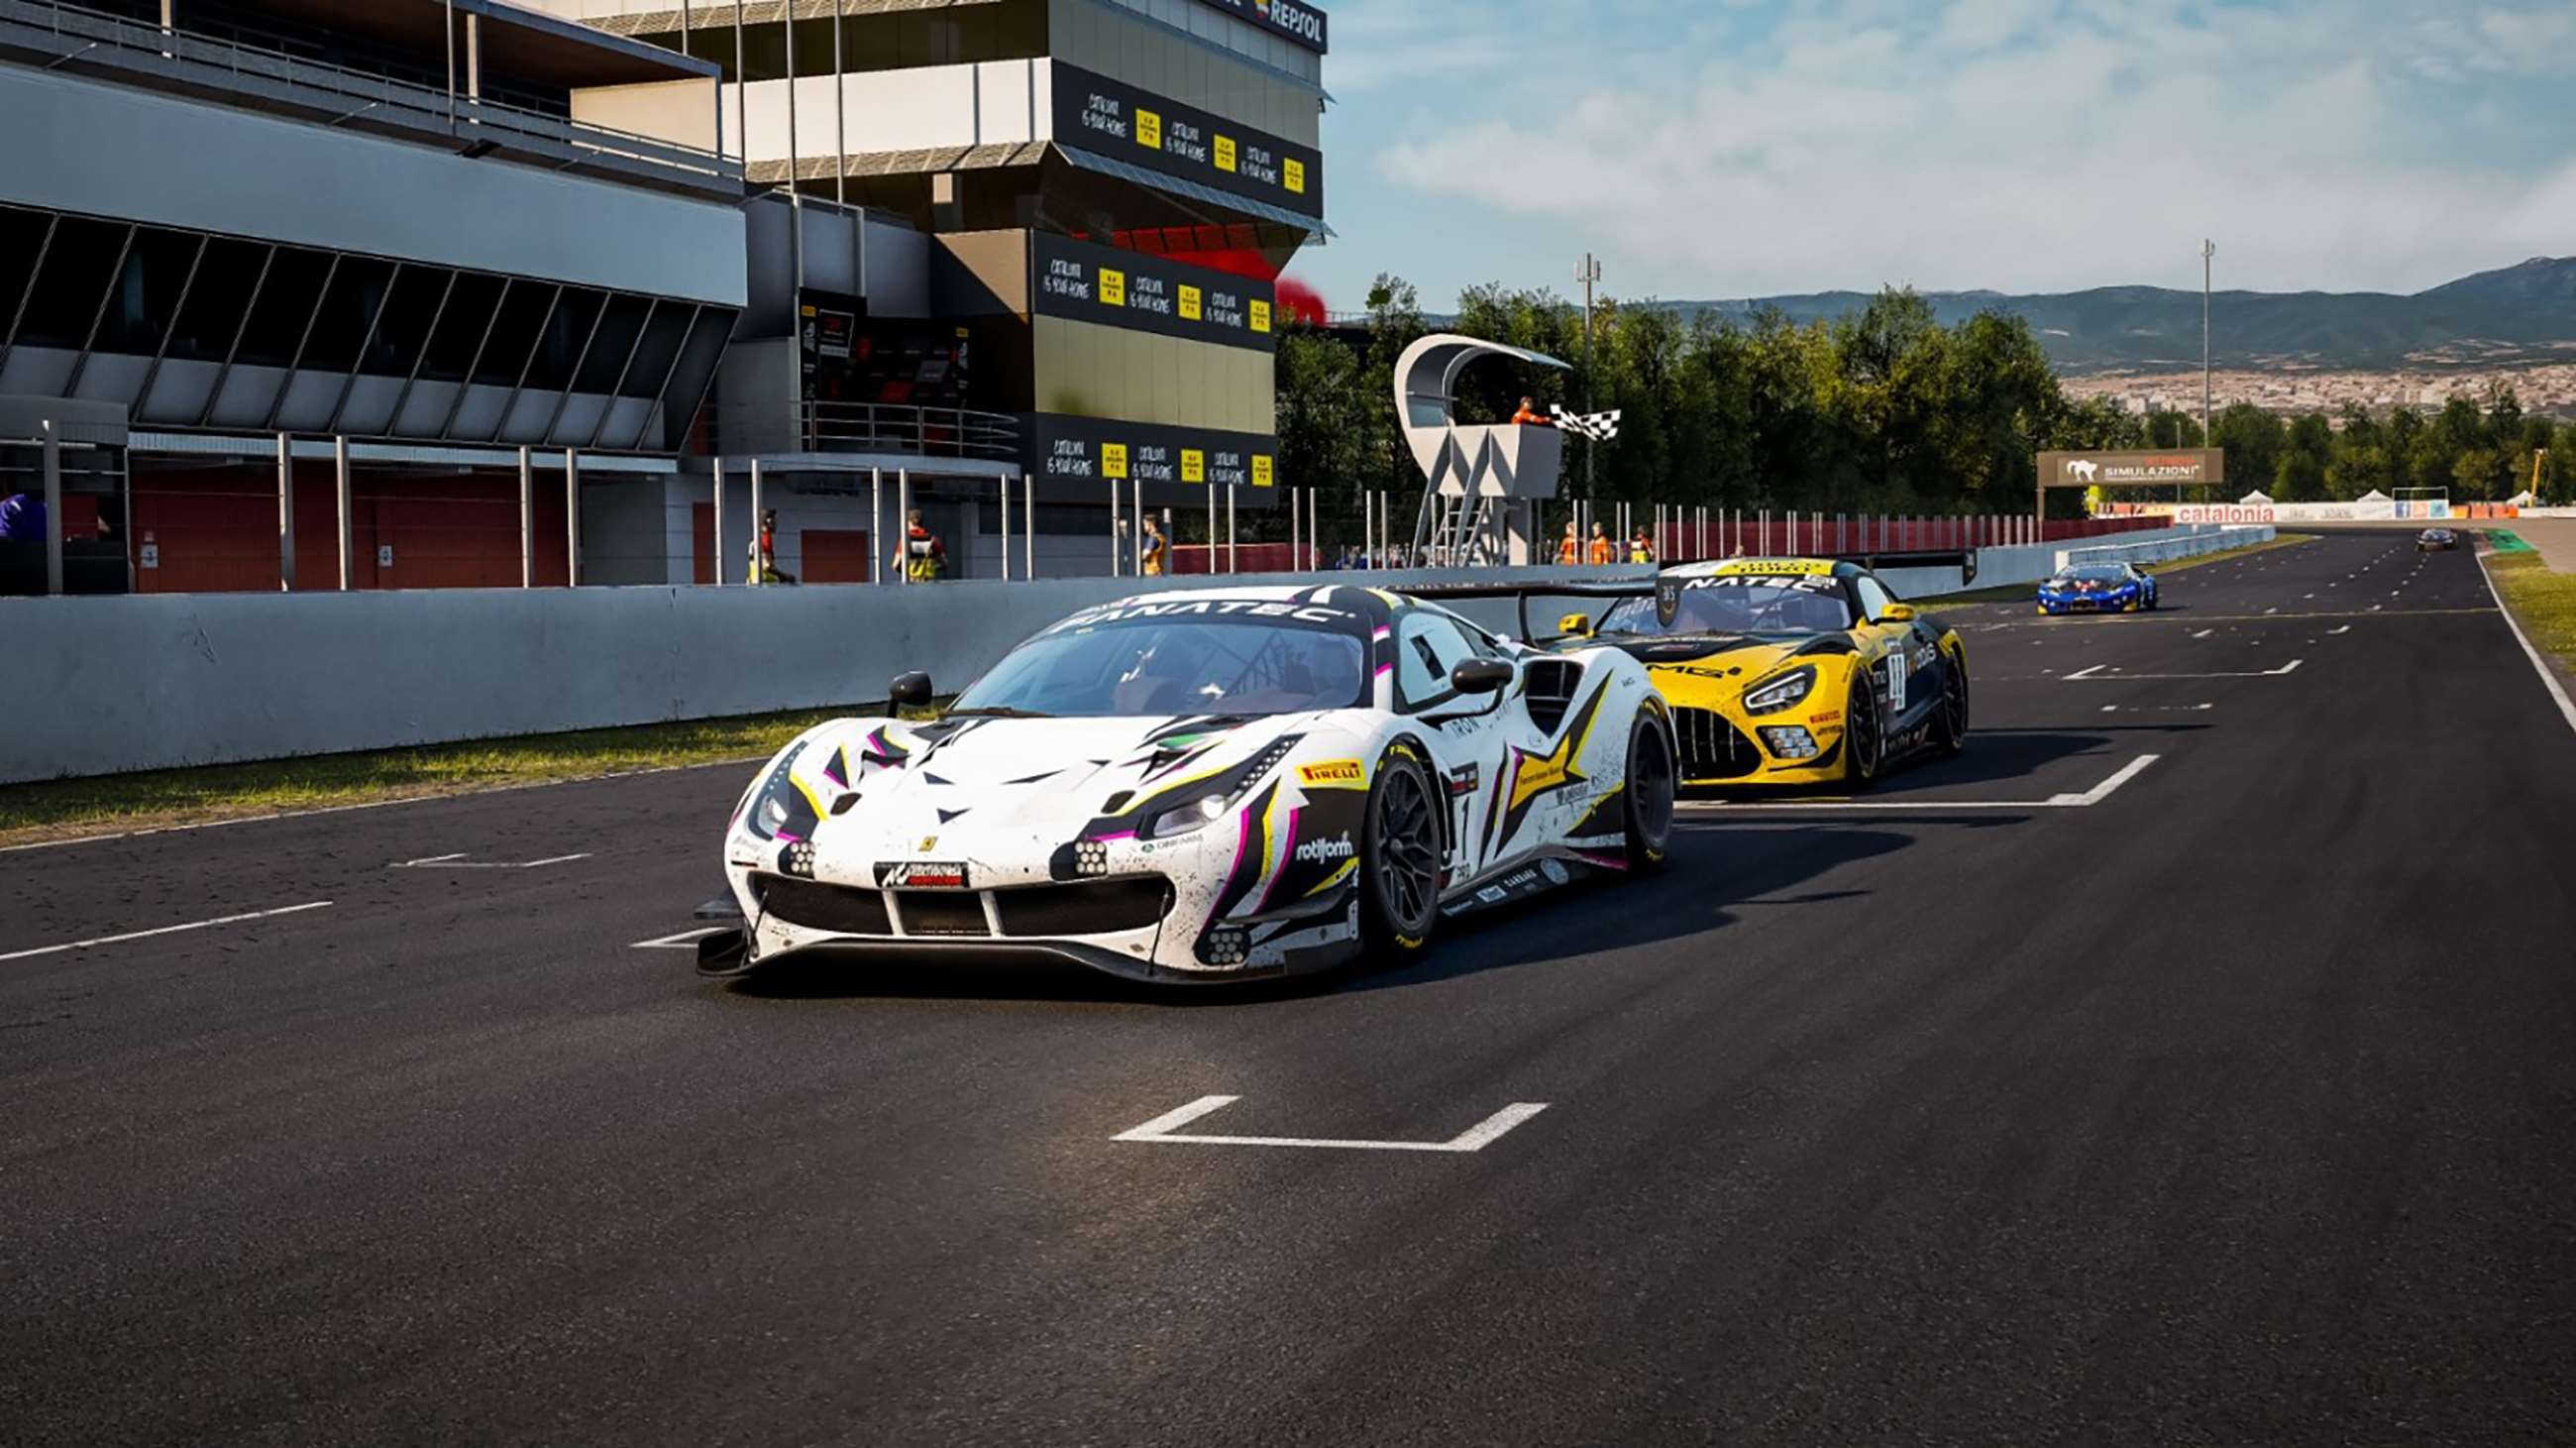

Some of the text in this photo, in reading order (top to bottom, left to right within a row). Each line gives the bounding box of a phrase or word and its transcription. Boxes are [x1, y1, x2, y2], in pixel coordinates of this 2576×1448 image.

[1270, 0, 1322, 42] REPSOL
[2104, 465, 2196, 477] SIMULAZIONI
[2180, 504, 2274, 523] catalonia
[1684, 575, 1817, 593] NATEC
[1302, 762, 1360, 780] PIRELLI
[1296, 830, 1353, 864] rotiform
